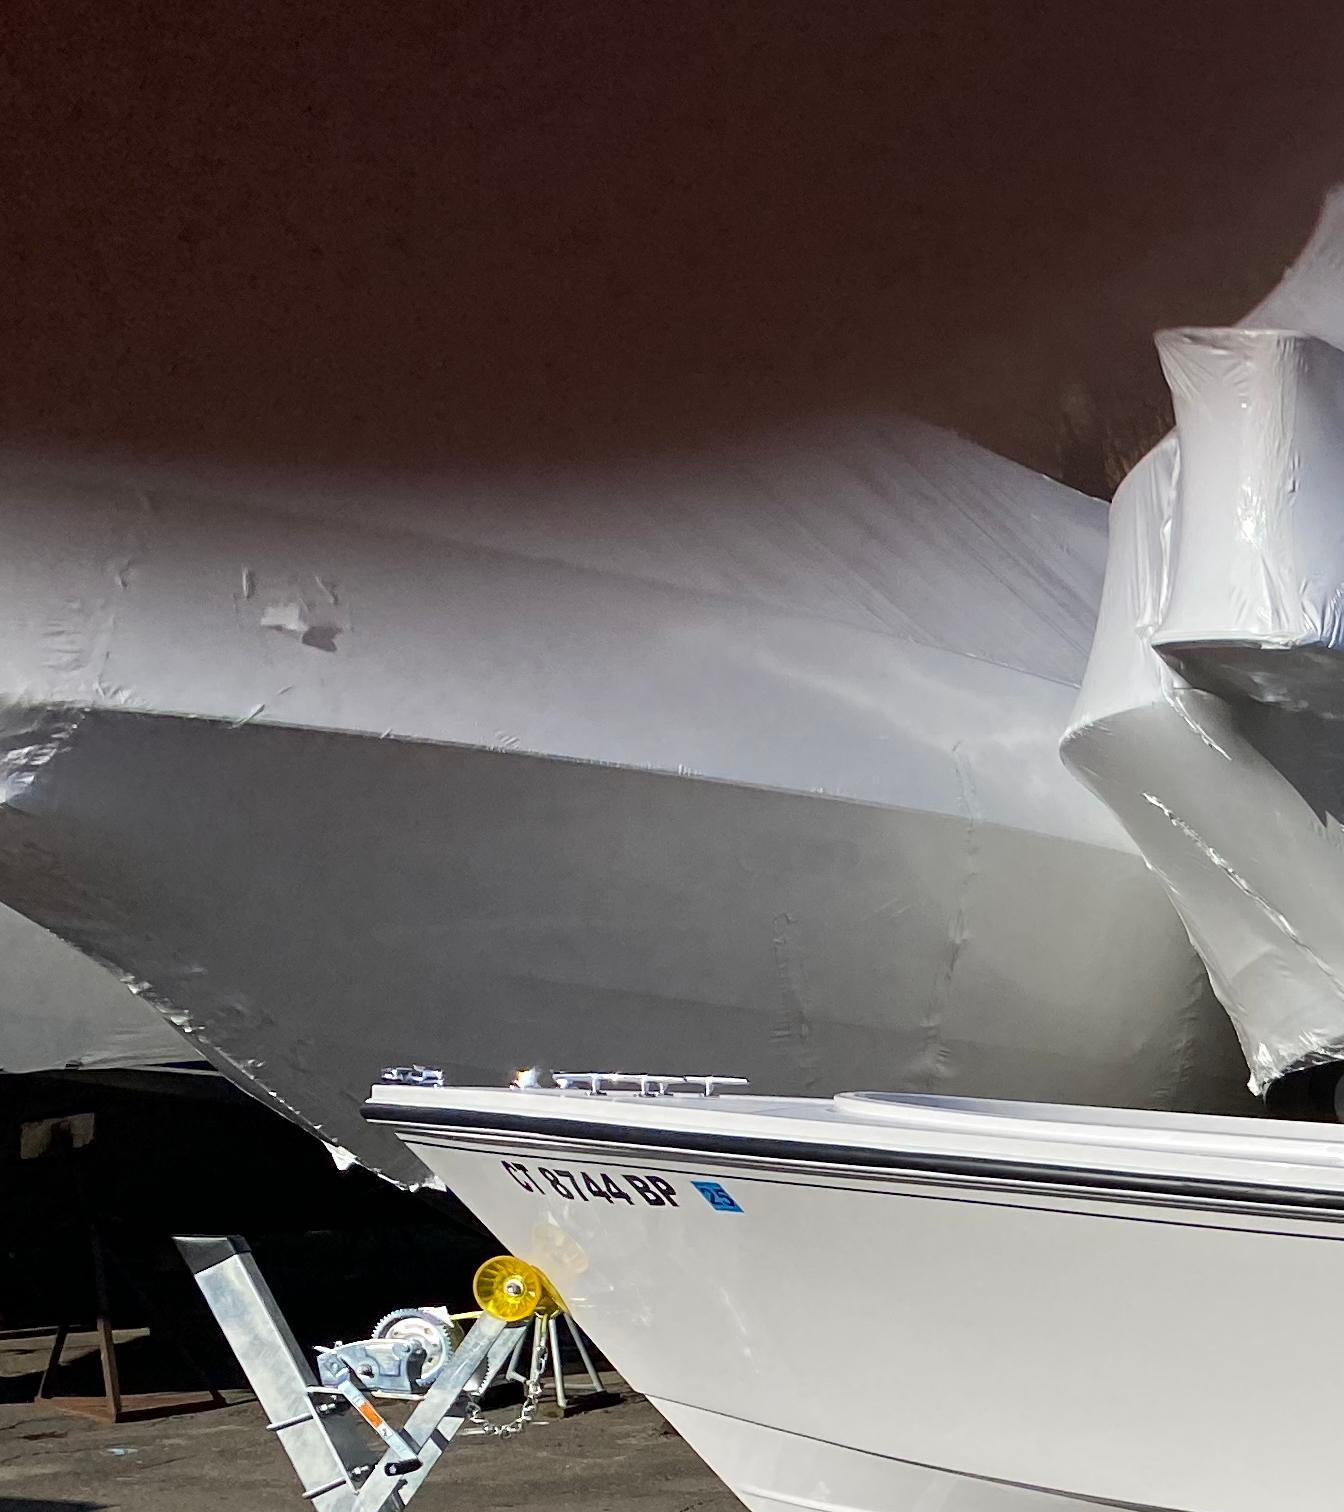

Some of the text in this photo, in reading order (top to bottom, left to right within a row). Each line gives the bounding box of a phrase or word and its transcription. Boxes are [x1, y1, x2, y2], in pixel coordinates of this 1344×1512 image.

[501, 1160, 680, 1207] CT 8744 BP
[702, 1181, 736, 1207] 25
